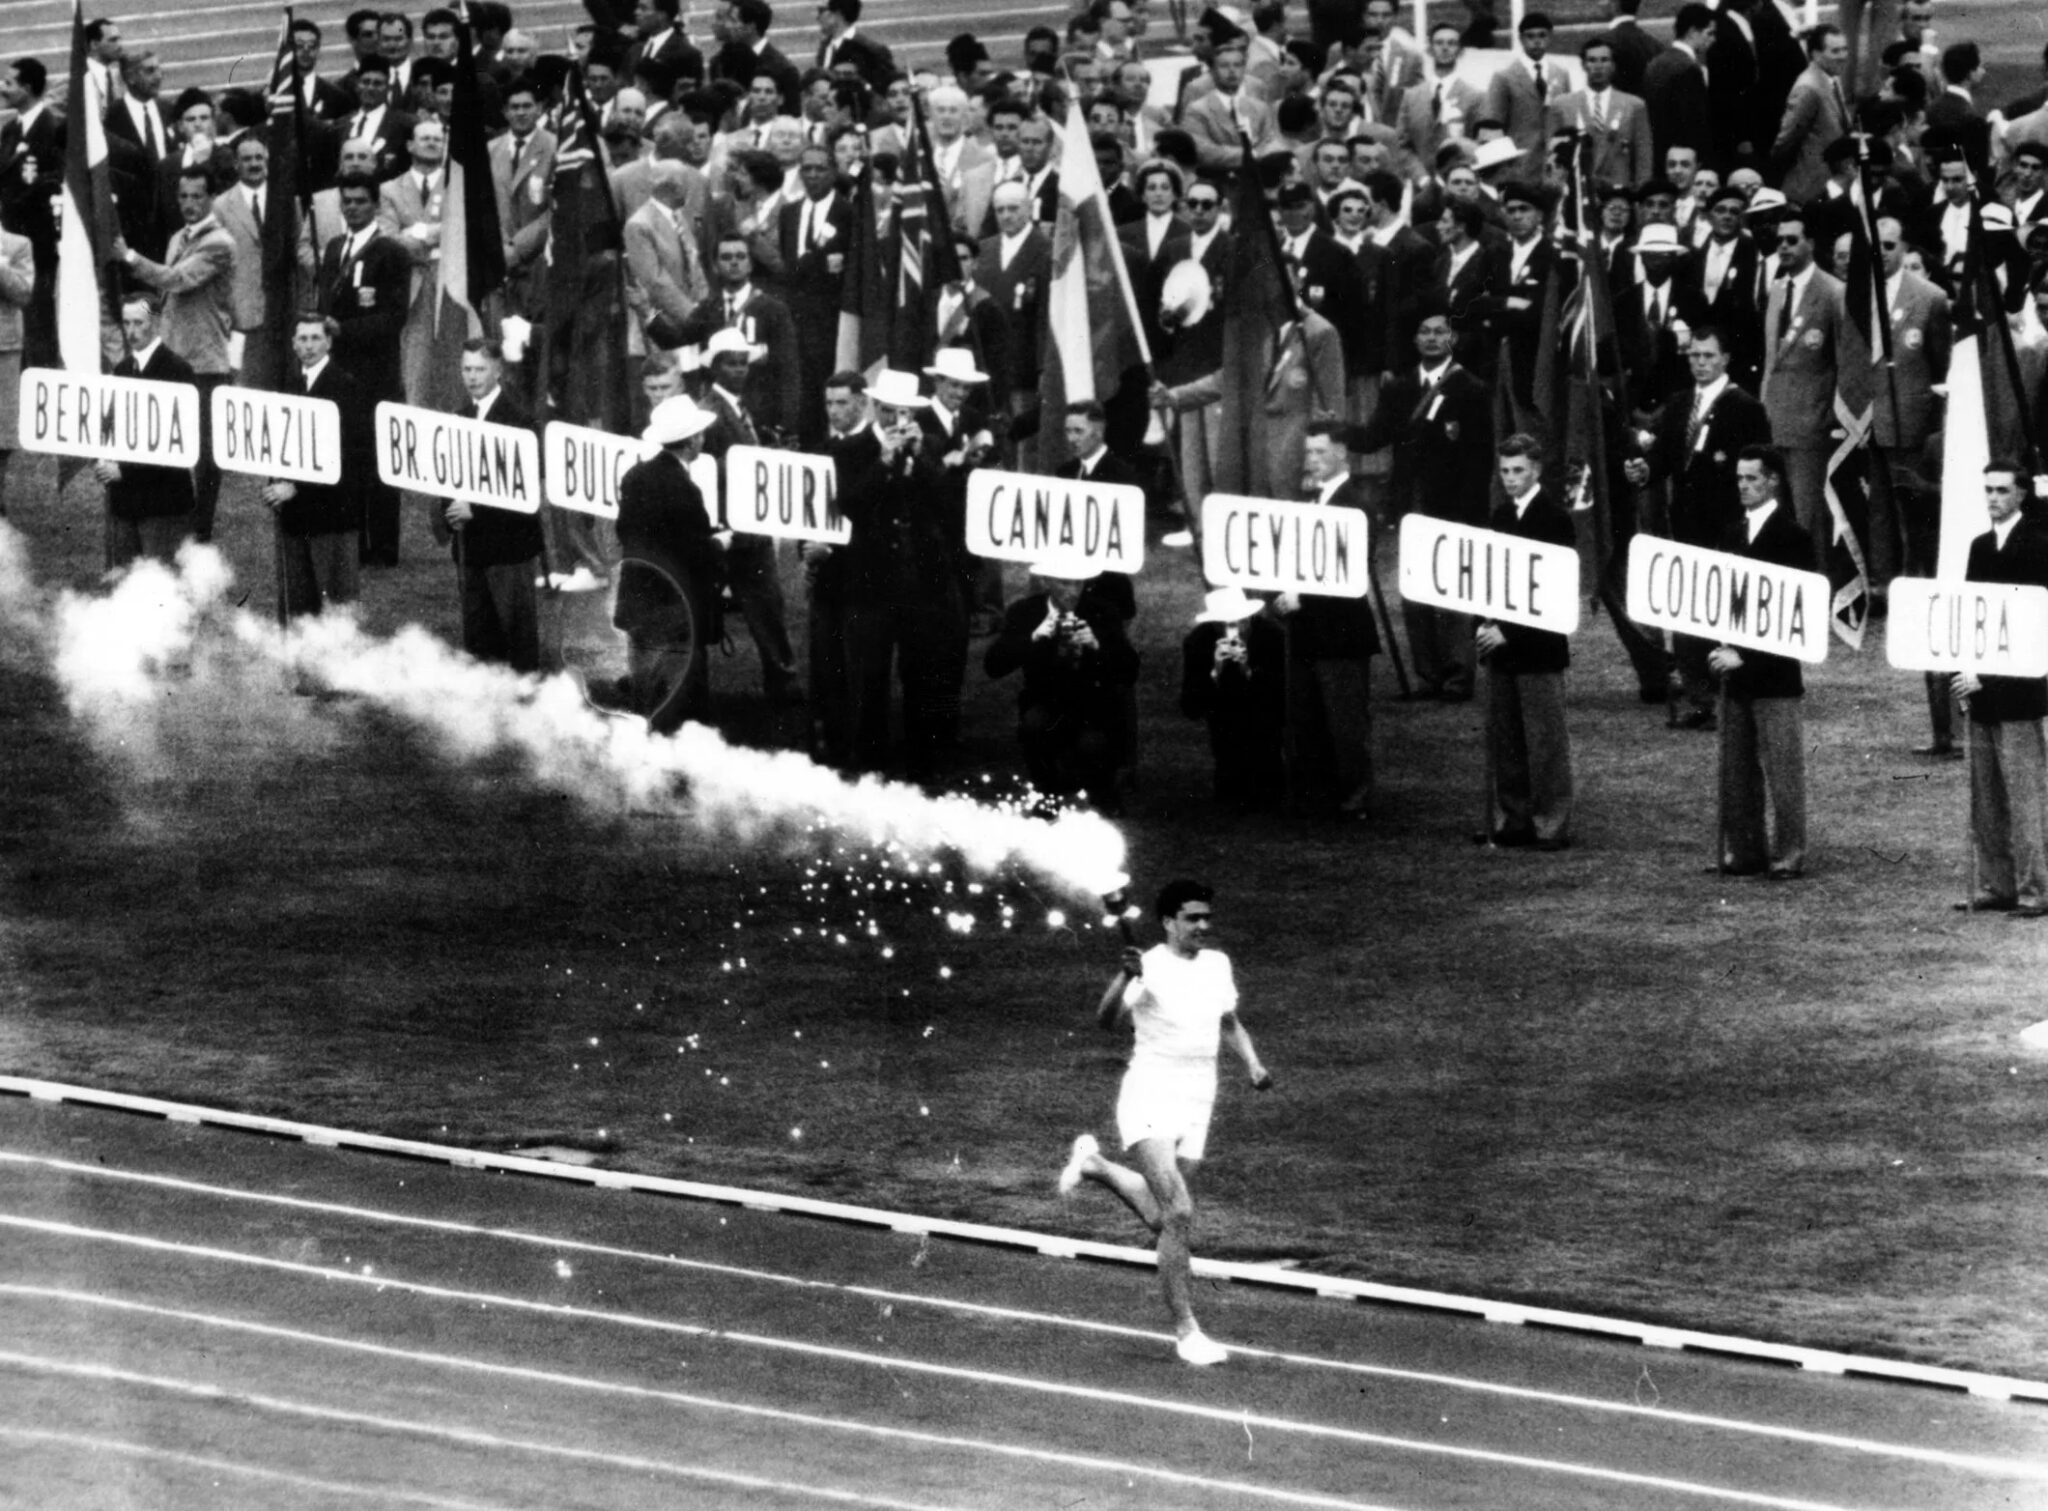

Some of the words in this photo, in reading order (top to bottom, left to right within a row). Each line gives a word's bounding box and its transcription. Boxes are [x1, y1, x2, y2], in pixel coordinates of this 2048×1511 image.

[35, 380, 186, 454] BERMUDA
[226, 399, 324, 472] BRAZIL
[755, 459, 843, 533] BURM
[988, 485, 1123, 561] CANADA
[1225, 510, 1349, 585] CEYLON
[1433, 534, 1543, 616] CHILE
[1648, 552, 1805, 647] COLOMBIA
[1927, 594, 2010, 660] CUBA
